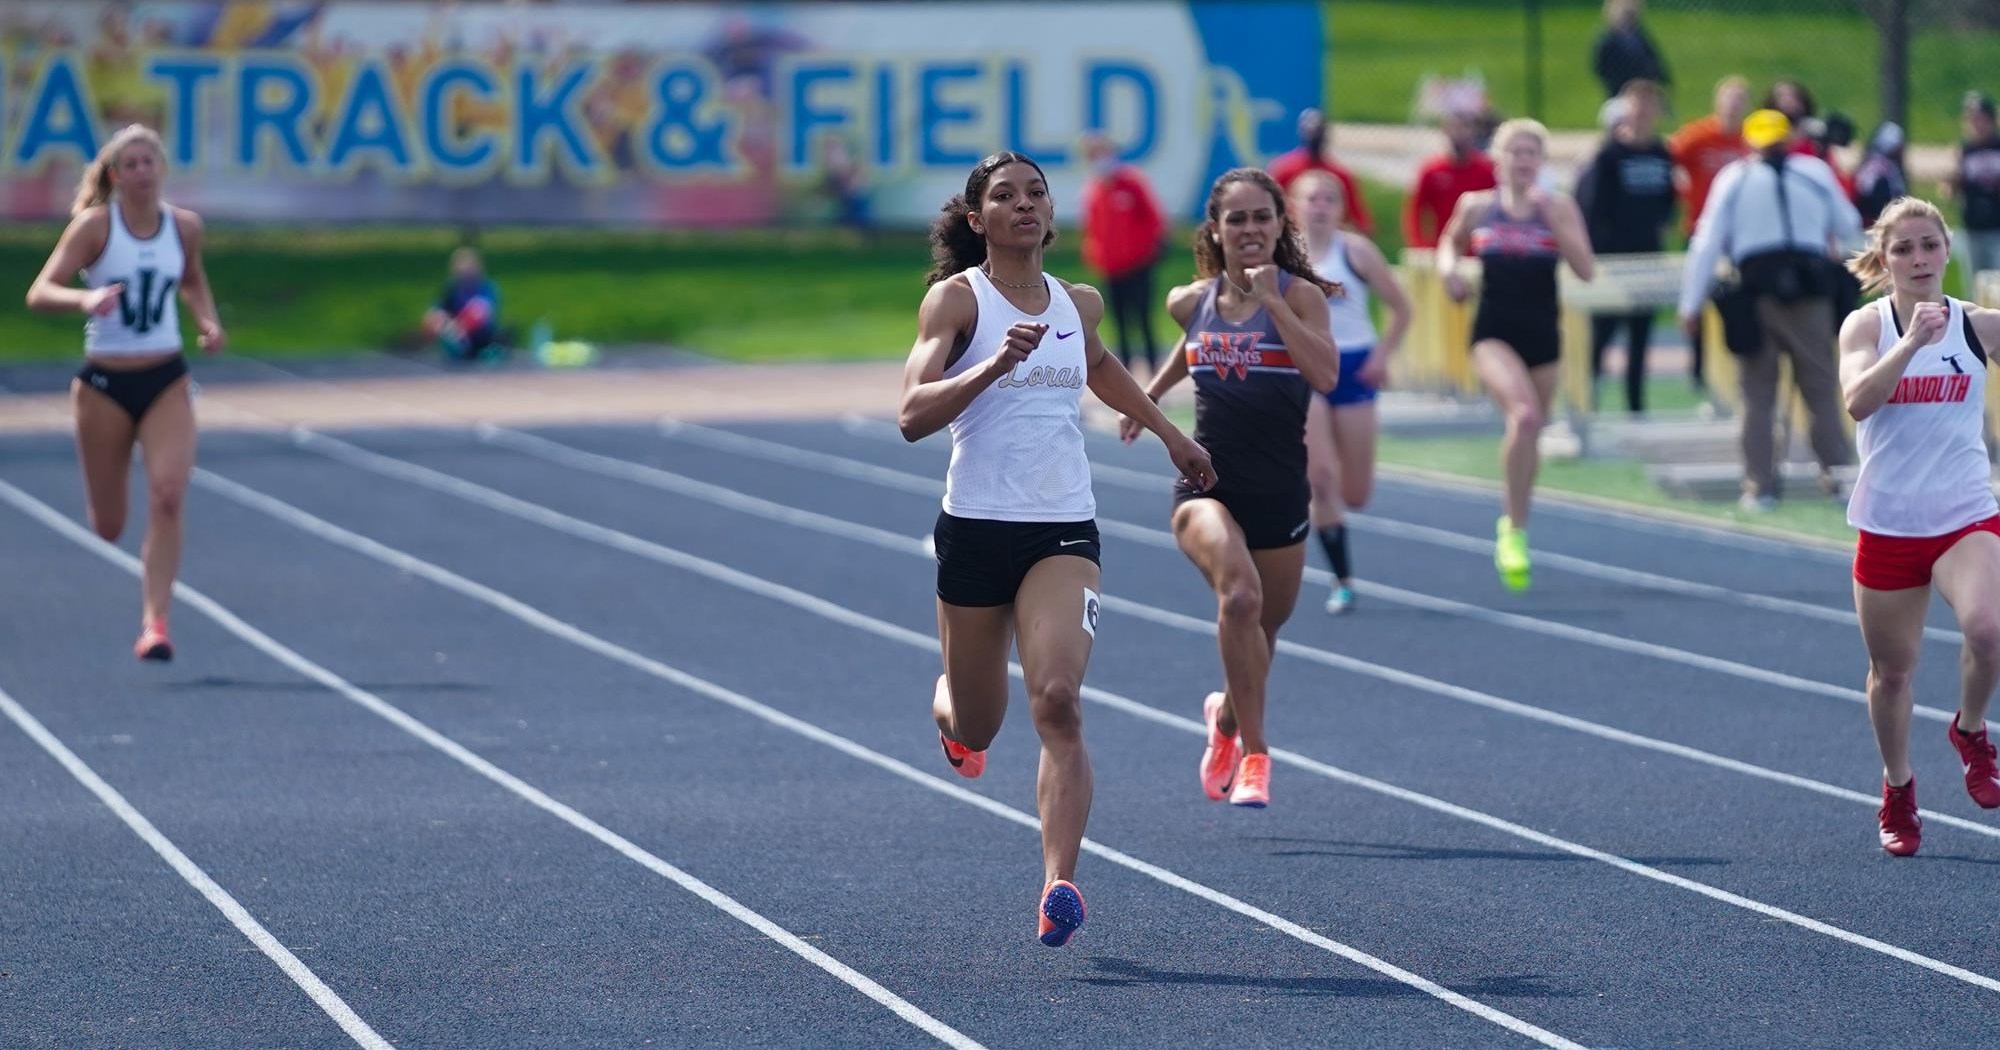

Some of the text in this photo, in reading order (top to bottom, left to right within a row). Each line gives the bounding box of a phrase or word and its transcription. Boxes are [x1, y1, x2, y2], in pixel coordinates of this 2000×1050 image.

[0, 60, 1158, 168] A TRACK & FIELD
[1197, 347, 1262, 366] Knights
[998, 363, 1083, 389] Loras
